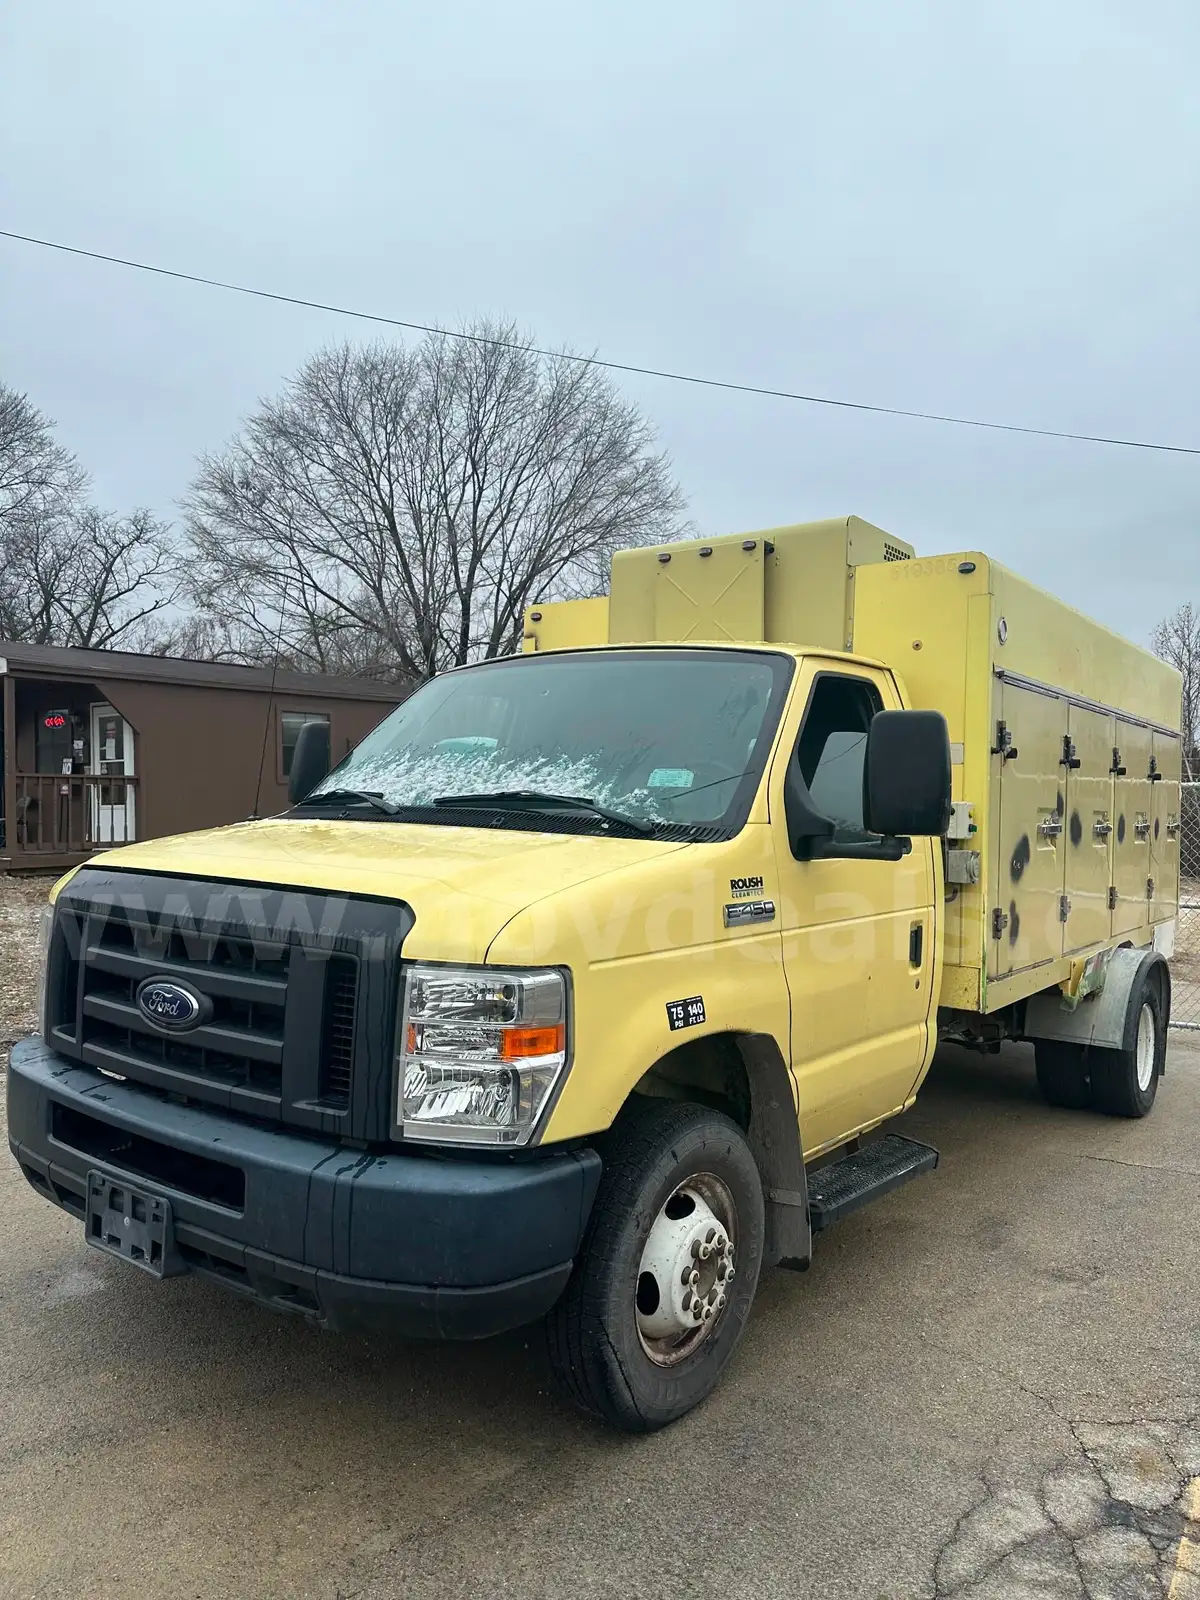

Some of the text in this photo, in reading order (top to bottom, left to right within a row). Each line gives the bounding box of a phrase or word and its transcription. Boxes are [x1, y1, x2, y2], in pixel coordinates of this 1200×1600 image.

[45, 716, 65, 727] OPEN
[730, 876, 763, 890] ROUSH
[148, 990, 181, 1016] Ford
[670, 1006, 684, 1020] 75
[687, 1002, 703, 1016] 140
[674, 1019, 684, 1029] PSI
